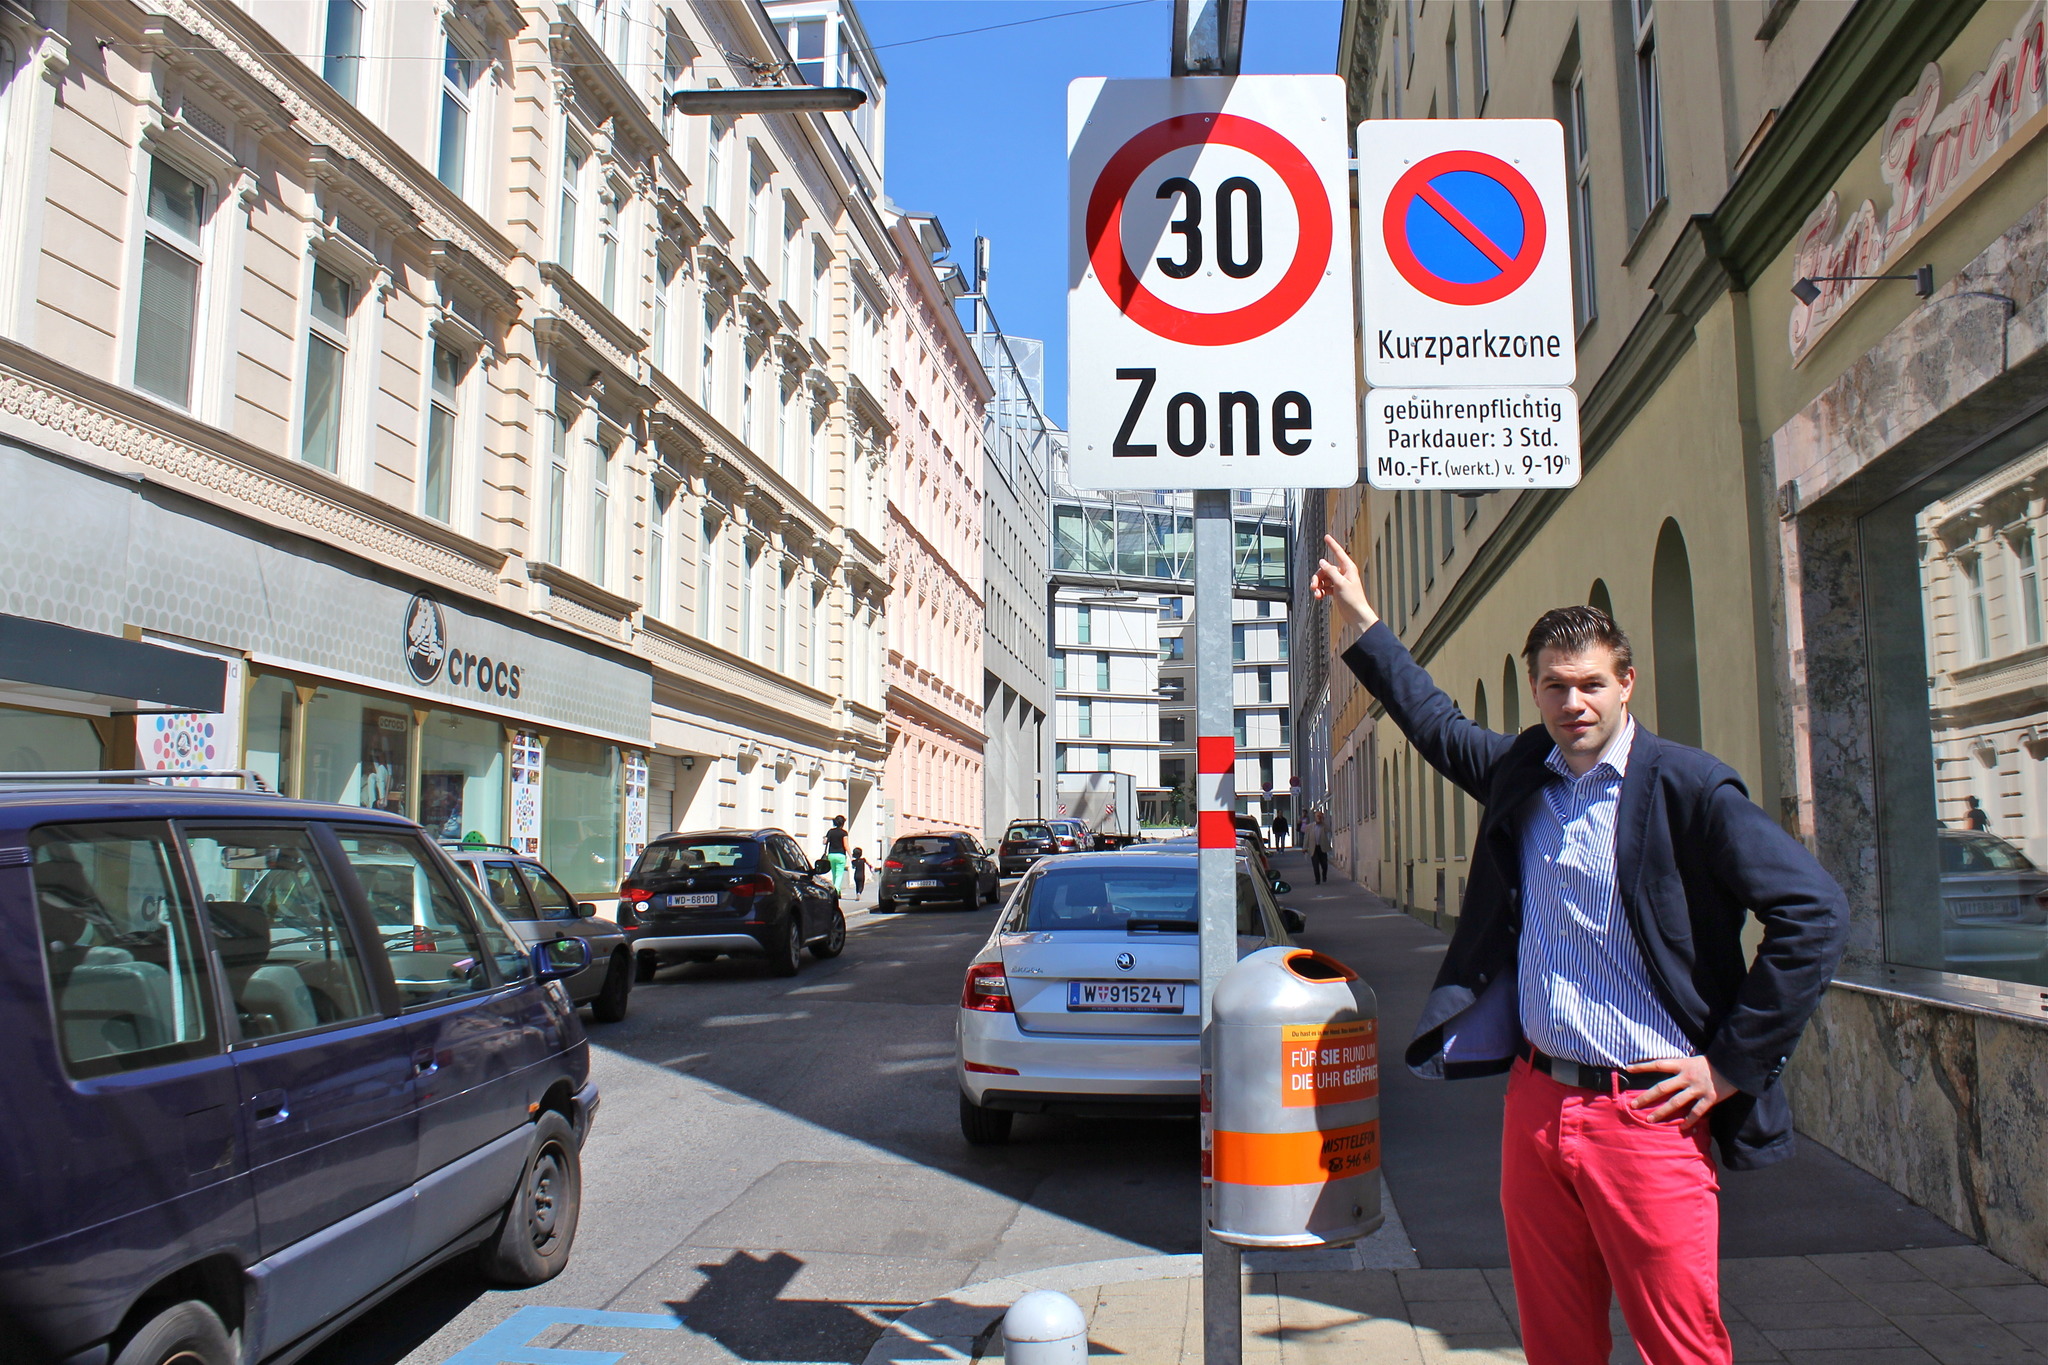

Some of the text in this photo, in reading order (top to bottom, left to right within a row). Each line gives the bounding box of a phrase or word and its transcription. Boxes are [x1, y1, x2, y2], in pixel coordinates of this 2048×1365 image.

[1155, 176, 1263, 279] 30
[1378, 329, 1561, 365] Kurzparkzone
[1112, 368, 1313, 458] Zone
[1383, 397, 1562, 424] gebührenpflichtig
[1388, 427, 1558, 449] Parkdauer: 3 Std.
[1378, 456, 1442, 477] Mo.-Fr.
[1444, 459, 1500, 478] (werkt.)
[1504, 464, 1516, 476] v.
[448, 648, 520, 700] crocs
[1291, 1047, 1317, 1068] FÜR
[1320, 1048, 1341, 1066] SIE
[1342, 1045, 1365, 1063] RUND
[1291, 1073, 1314, 1091] DIE
[1316, 1071, 1341, 1089] UHR
[1321, 1130, 1375, 1154] MISTTELEFON
